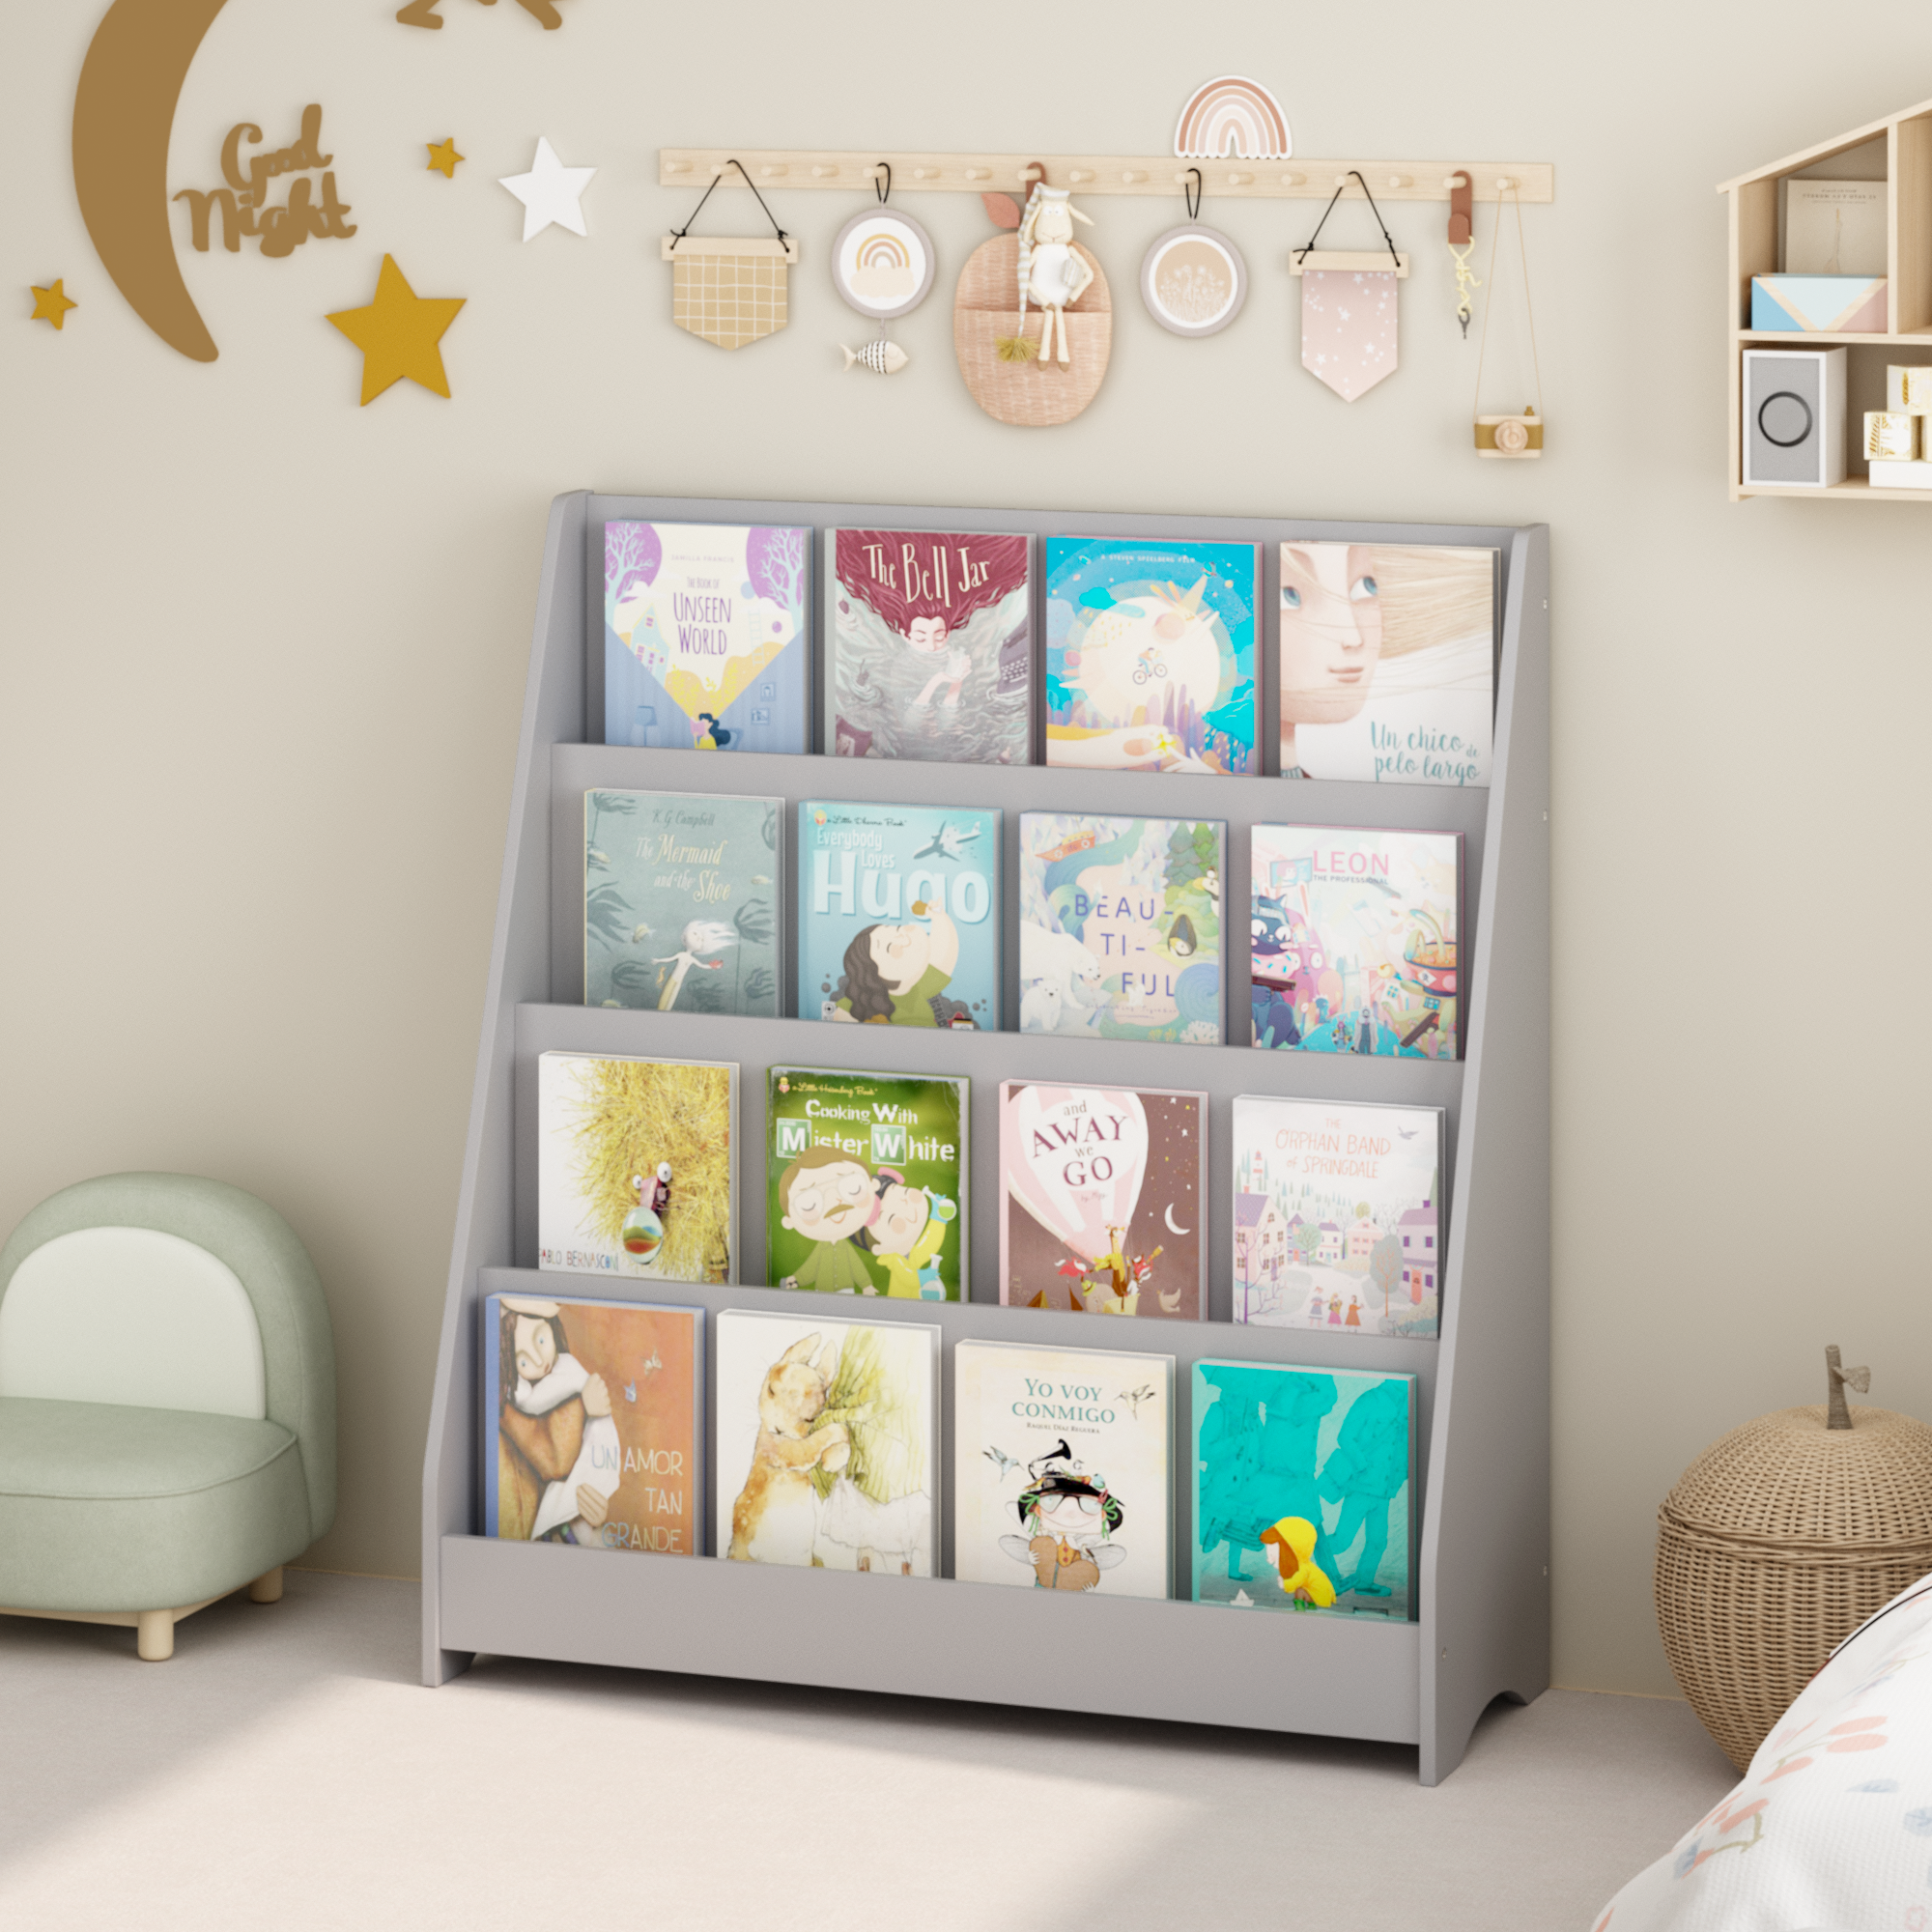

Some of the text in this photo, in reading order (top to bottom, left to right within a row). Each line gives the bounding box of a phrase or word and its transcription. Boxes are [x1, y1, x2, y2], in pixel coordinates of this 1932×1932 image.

[862, 543, 990, 608] The Bell Jar
[673, 592, 731, 623] UNSEEN
[678, 624, 727, 655] WORLD
[1371, 721, 1478, 757] Un chico de
[1375, 752, 1480, 786] pelo largo
[636, 833, 728, 866] The Mermaid
[816, 827, 883, 851] Everybody
[861, 850, 895, 868] Loves
[1313, 850, 1388, 875] LEON
[654, 869, 731, 904] and the Shoe
[813, 850, 991, 935] Hugo
[1330, 875, 1388, 885] PROFESSIONAL
[1122, 972, 1175, 997] FUL
[806, 1099, 918, 1125] Cooking With
[1064, 1099, 1087, 1116] and
[1033, 1115, 1128, 1158] AWAY
[1325, 1118, 1341, 1129] THE
[782, 1126, 869, 1156] Mister
[874, 1133, 955, 1162] White
[1074, 1146, 1094, 1157] we
[1275, 1128, 1391, 1155] ORPHAN BAND
[1063, 1156, 1113, 1186] GO
[1287, 1155, 1379, 1179] of SPRINGDALE
[539, 1248, 562, 1264] ABLO
[1060, 1384, 1102, 1402] VOY
[1012, 1402, 1115, 1424] CONMIGO
[592, 1444, 683, 1477] UN AMOR
[644, 1487, 683, 1516] TAN
[601, 1521, 683, 1553] GRANDE
